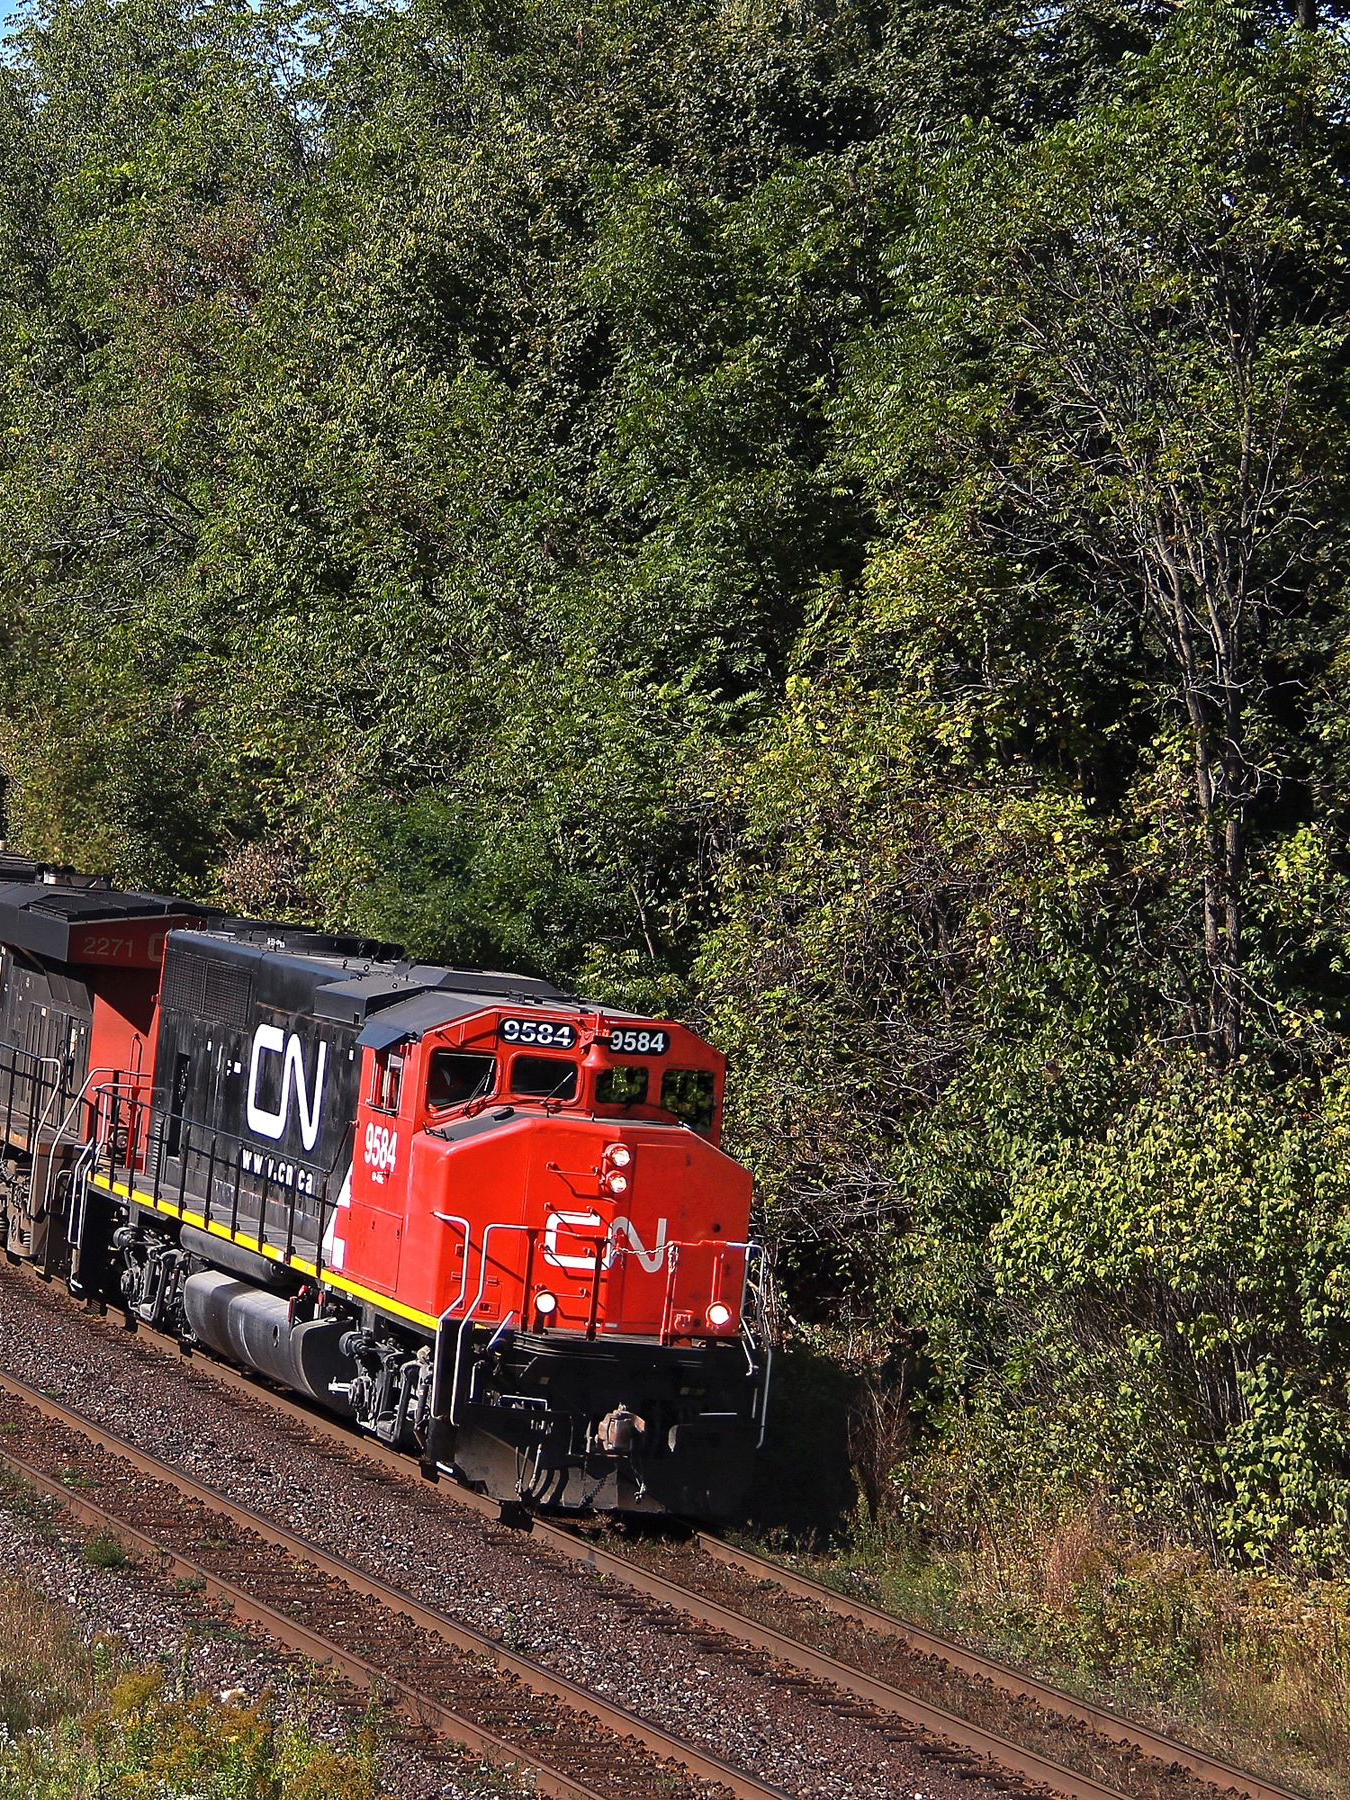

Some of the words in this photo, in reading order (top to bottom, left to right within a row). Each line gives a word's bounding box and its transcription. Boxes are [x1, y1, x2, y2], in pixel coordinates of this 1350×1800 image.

[82, 936, 134, 957] 2271
[147, 932, 166, 963] C
[503, 1020, 572, 1047] 9584
[609, 1030, 665, 1052] 9584
[246, 1023, 328, 1152] CN
[364, 1121, 398, 1173] 9584
[241, 1148, 314, 1195] www.cnca
[543, 1210, 668, 1274] CN
